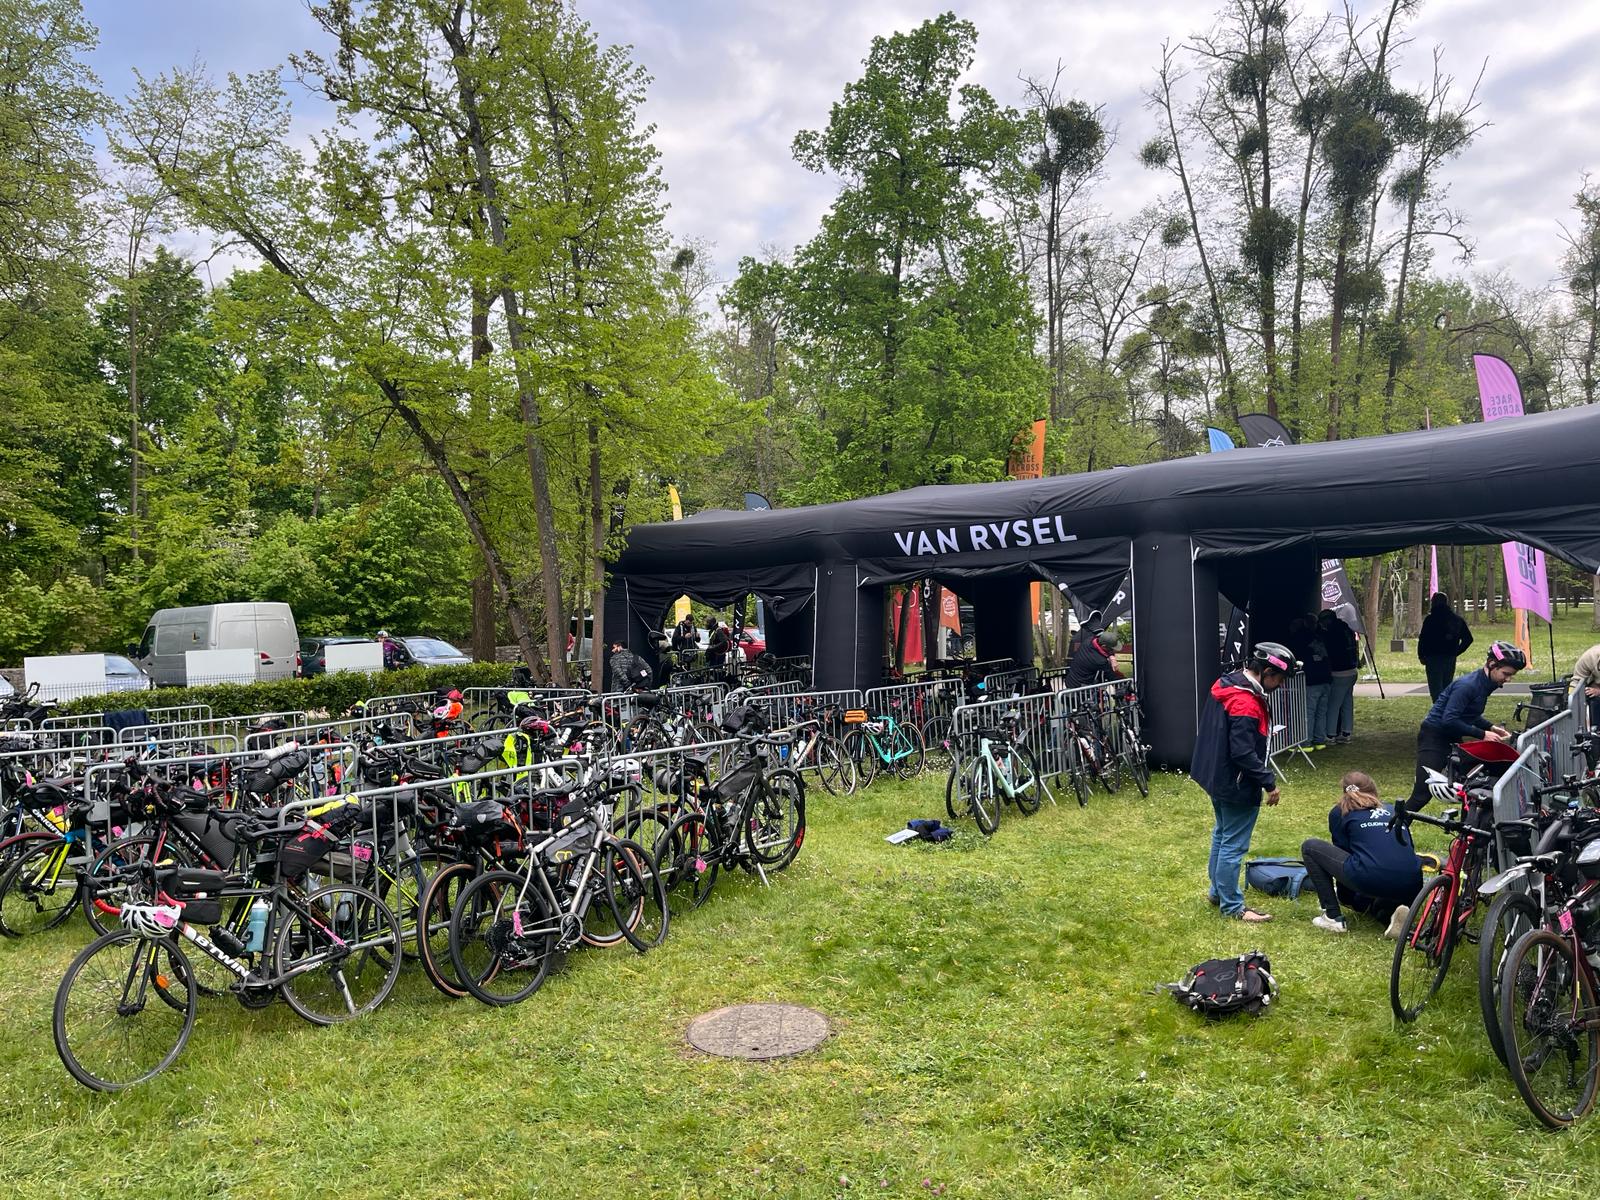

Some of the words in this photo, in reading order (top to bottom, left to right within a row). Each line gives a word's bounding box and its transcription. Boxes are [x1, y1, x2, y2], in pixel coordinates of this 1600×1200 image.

[1011, 463, 1040, 472] ACROSS
[893, 527, 961, 557] VAN
[969, 515, 1078, 551] RYSEL
